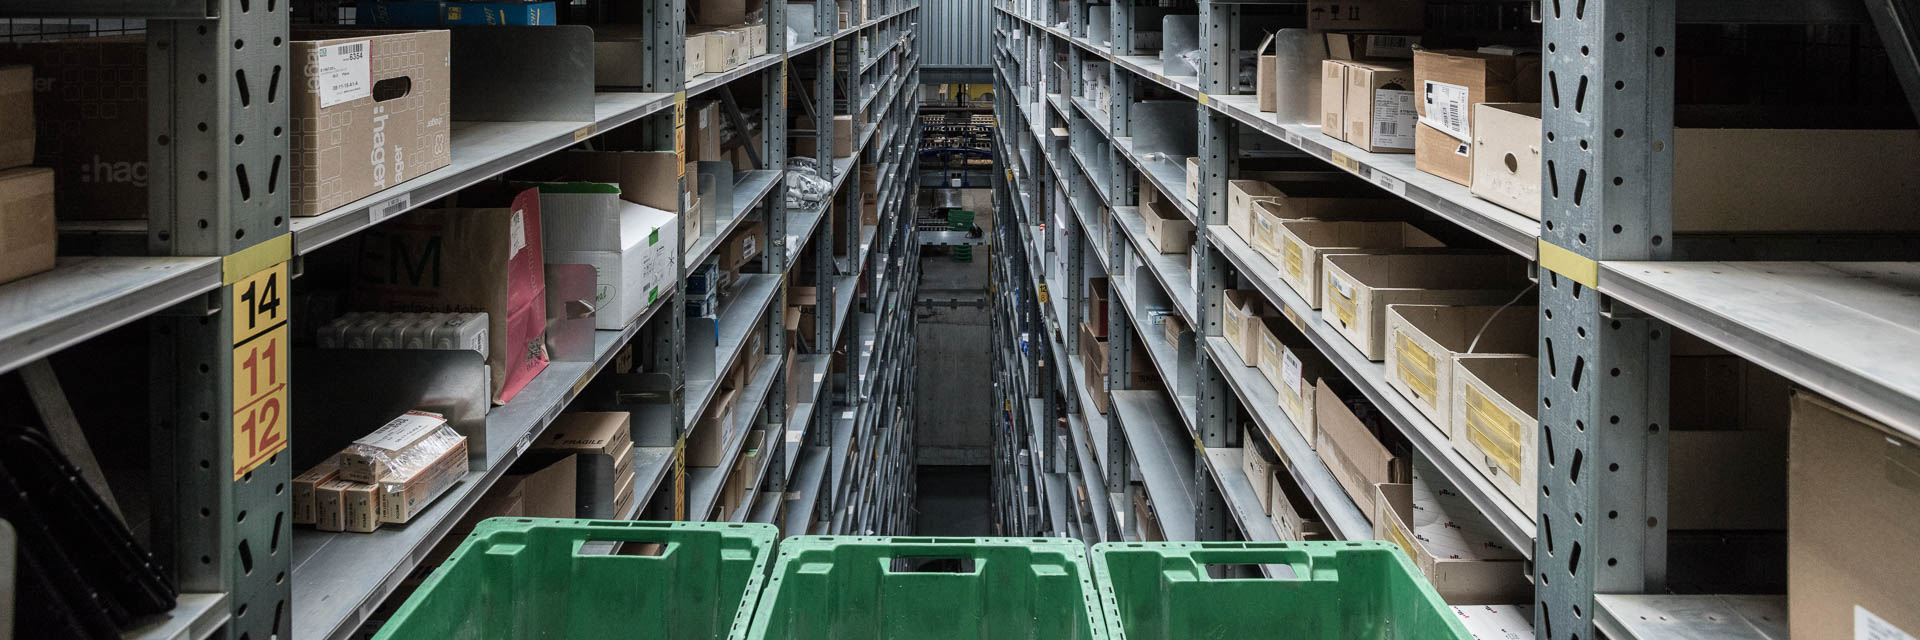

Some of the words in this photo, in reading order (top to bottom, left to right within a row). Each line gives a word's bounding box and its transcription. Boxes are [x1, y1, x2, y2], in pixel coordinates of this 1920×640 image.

[82, 155, 148, 187] :hag
[394, 145, 404, 183] ager
[241, 272, 281, 330] 14
[242, 337, 277, 397] 11
[241, 397, 281, 459] 12
